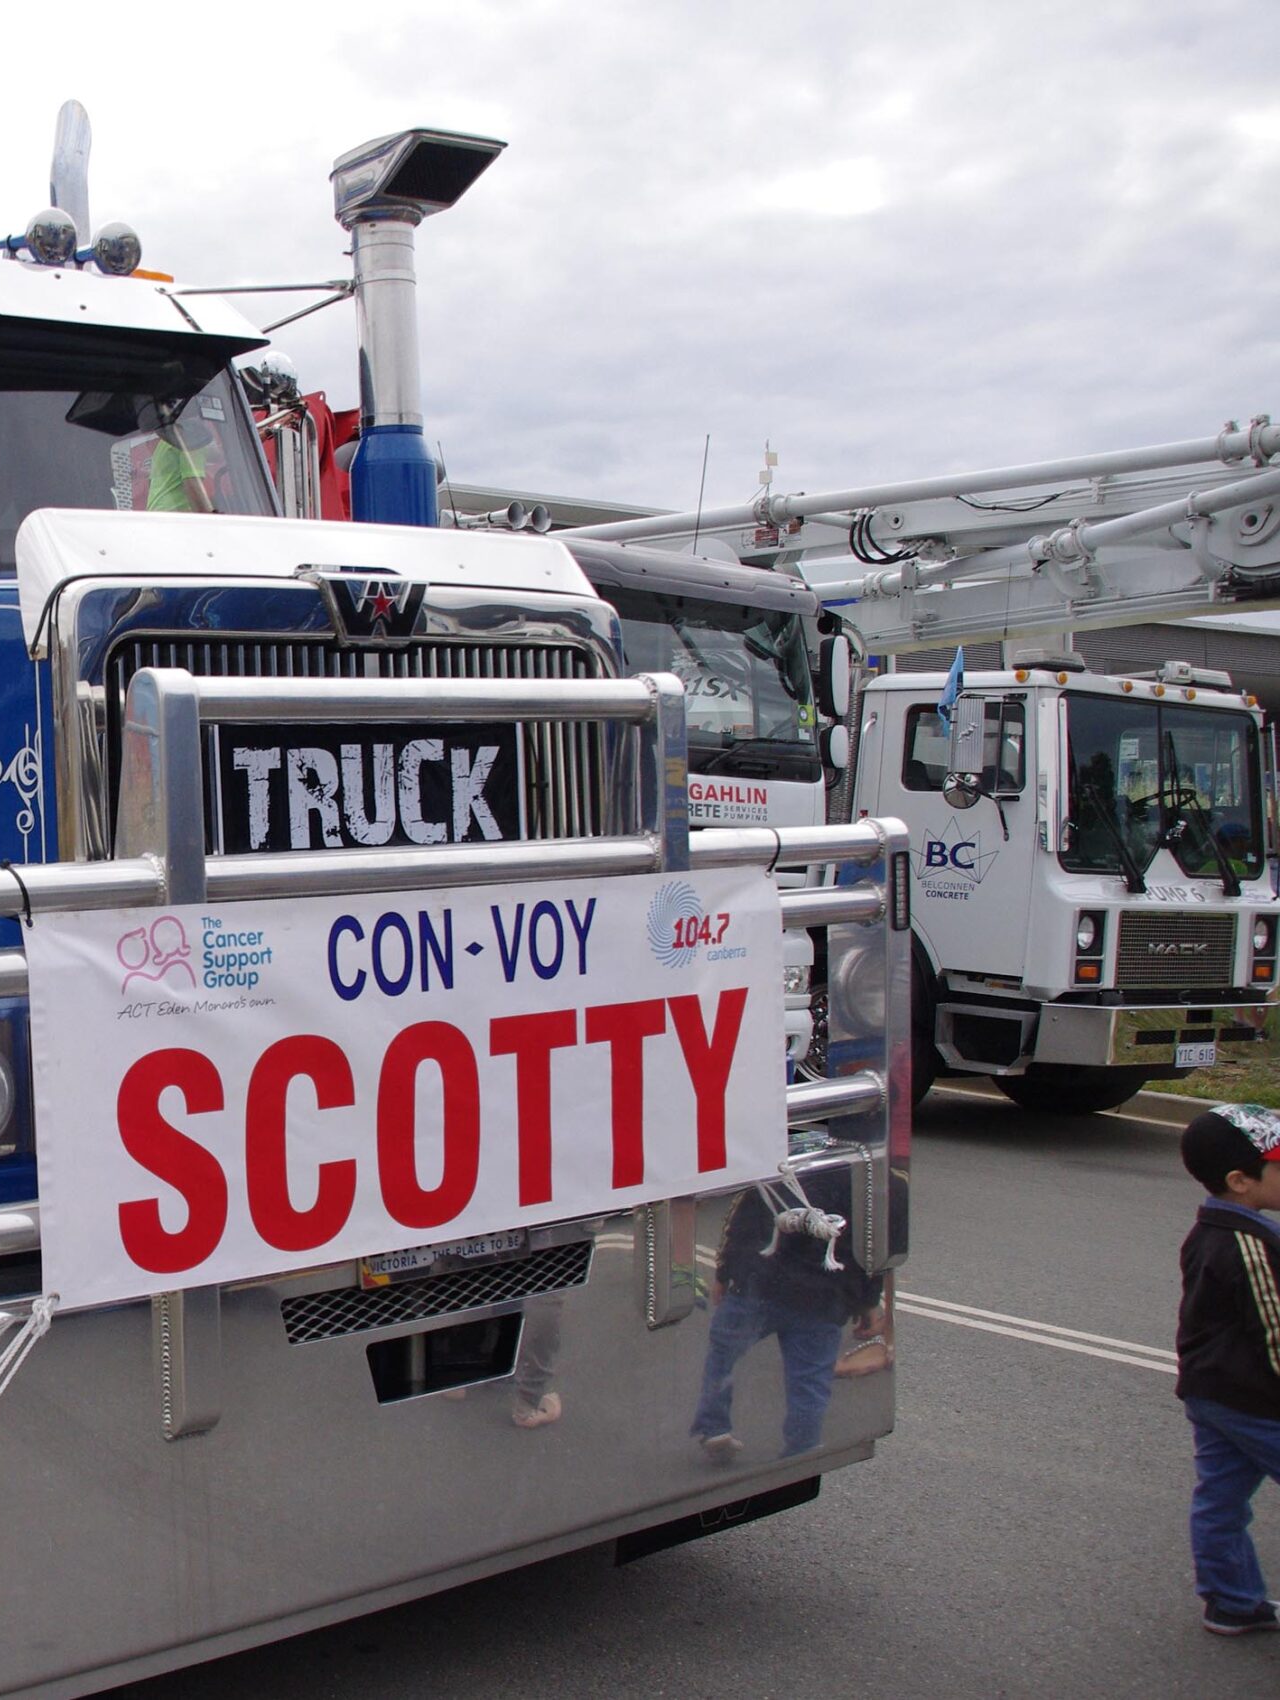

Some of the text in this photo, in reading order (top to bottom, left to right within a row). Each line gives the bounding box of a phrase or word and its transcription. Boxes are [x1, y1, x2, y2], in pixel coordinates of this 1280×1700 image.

[232, 738, 503, 850] TRUCK
[689, 782, 768, 805] GAHLIN
[724, 805, 768, 814] SERVICES
[724, 814, 768, 822] PUMPING
[925, 841, 976, 869] BC
[921, 880, 976, 891] BELCONNEN
[925, 889, 970, 900] CONCRETE
[1144, 886, 1205, 902] PUMP 6
[202, 917, 222, 929] The
[672, 913, 730, 949] 104.7
[203, 931, 264, 949] Cancer
[1147, 943, 1209, 955] MACK
[203, 947, 273, 971] Support
[707, 946, 747, 961] canberra
[204, 970, 259, 990] Group
[117, 1001, 156, 1020] ACT
[157, 1001, 191, 1016] Eden
[249, 997, 277, 1009] own
[117, 987, 749, 1274] SCOTTY
[372, 1254, 418, 1273] VICTORIA
[456, 1242, 486, 1257] PLACE
[491, 1239, 503, 1250] TO
[508, 1235, 519, 1247] BE
